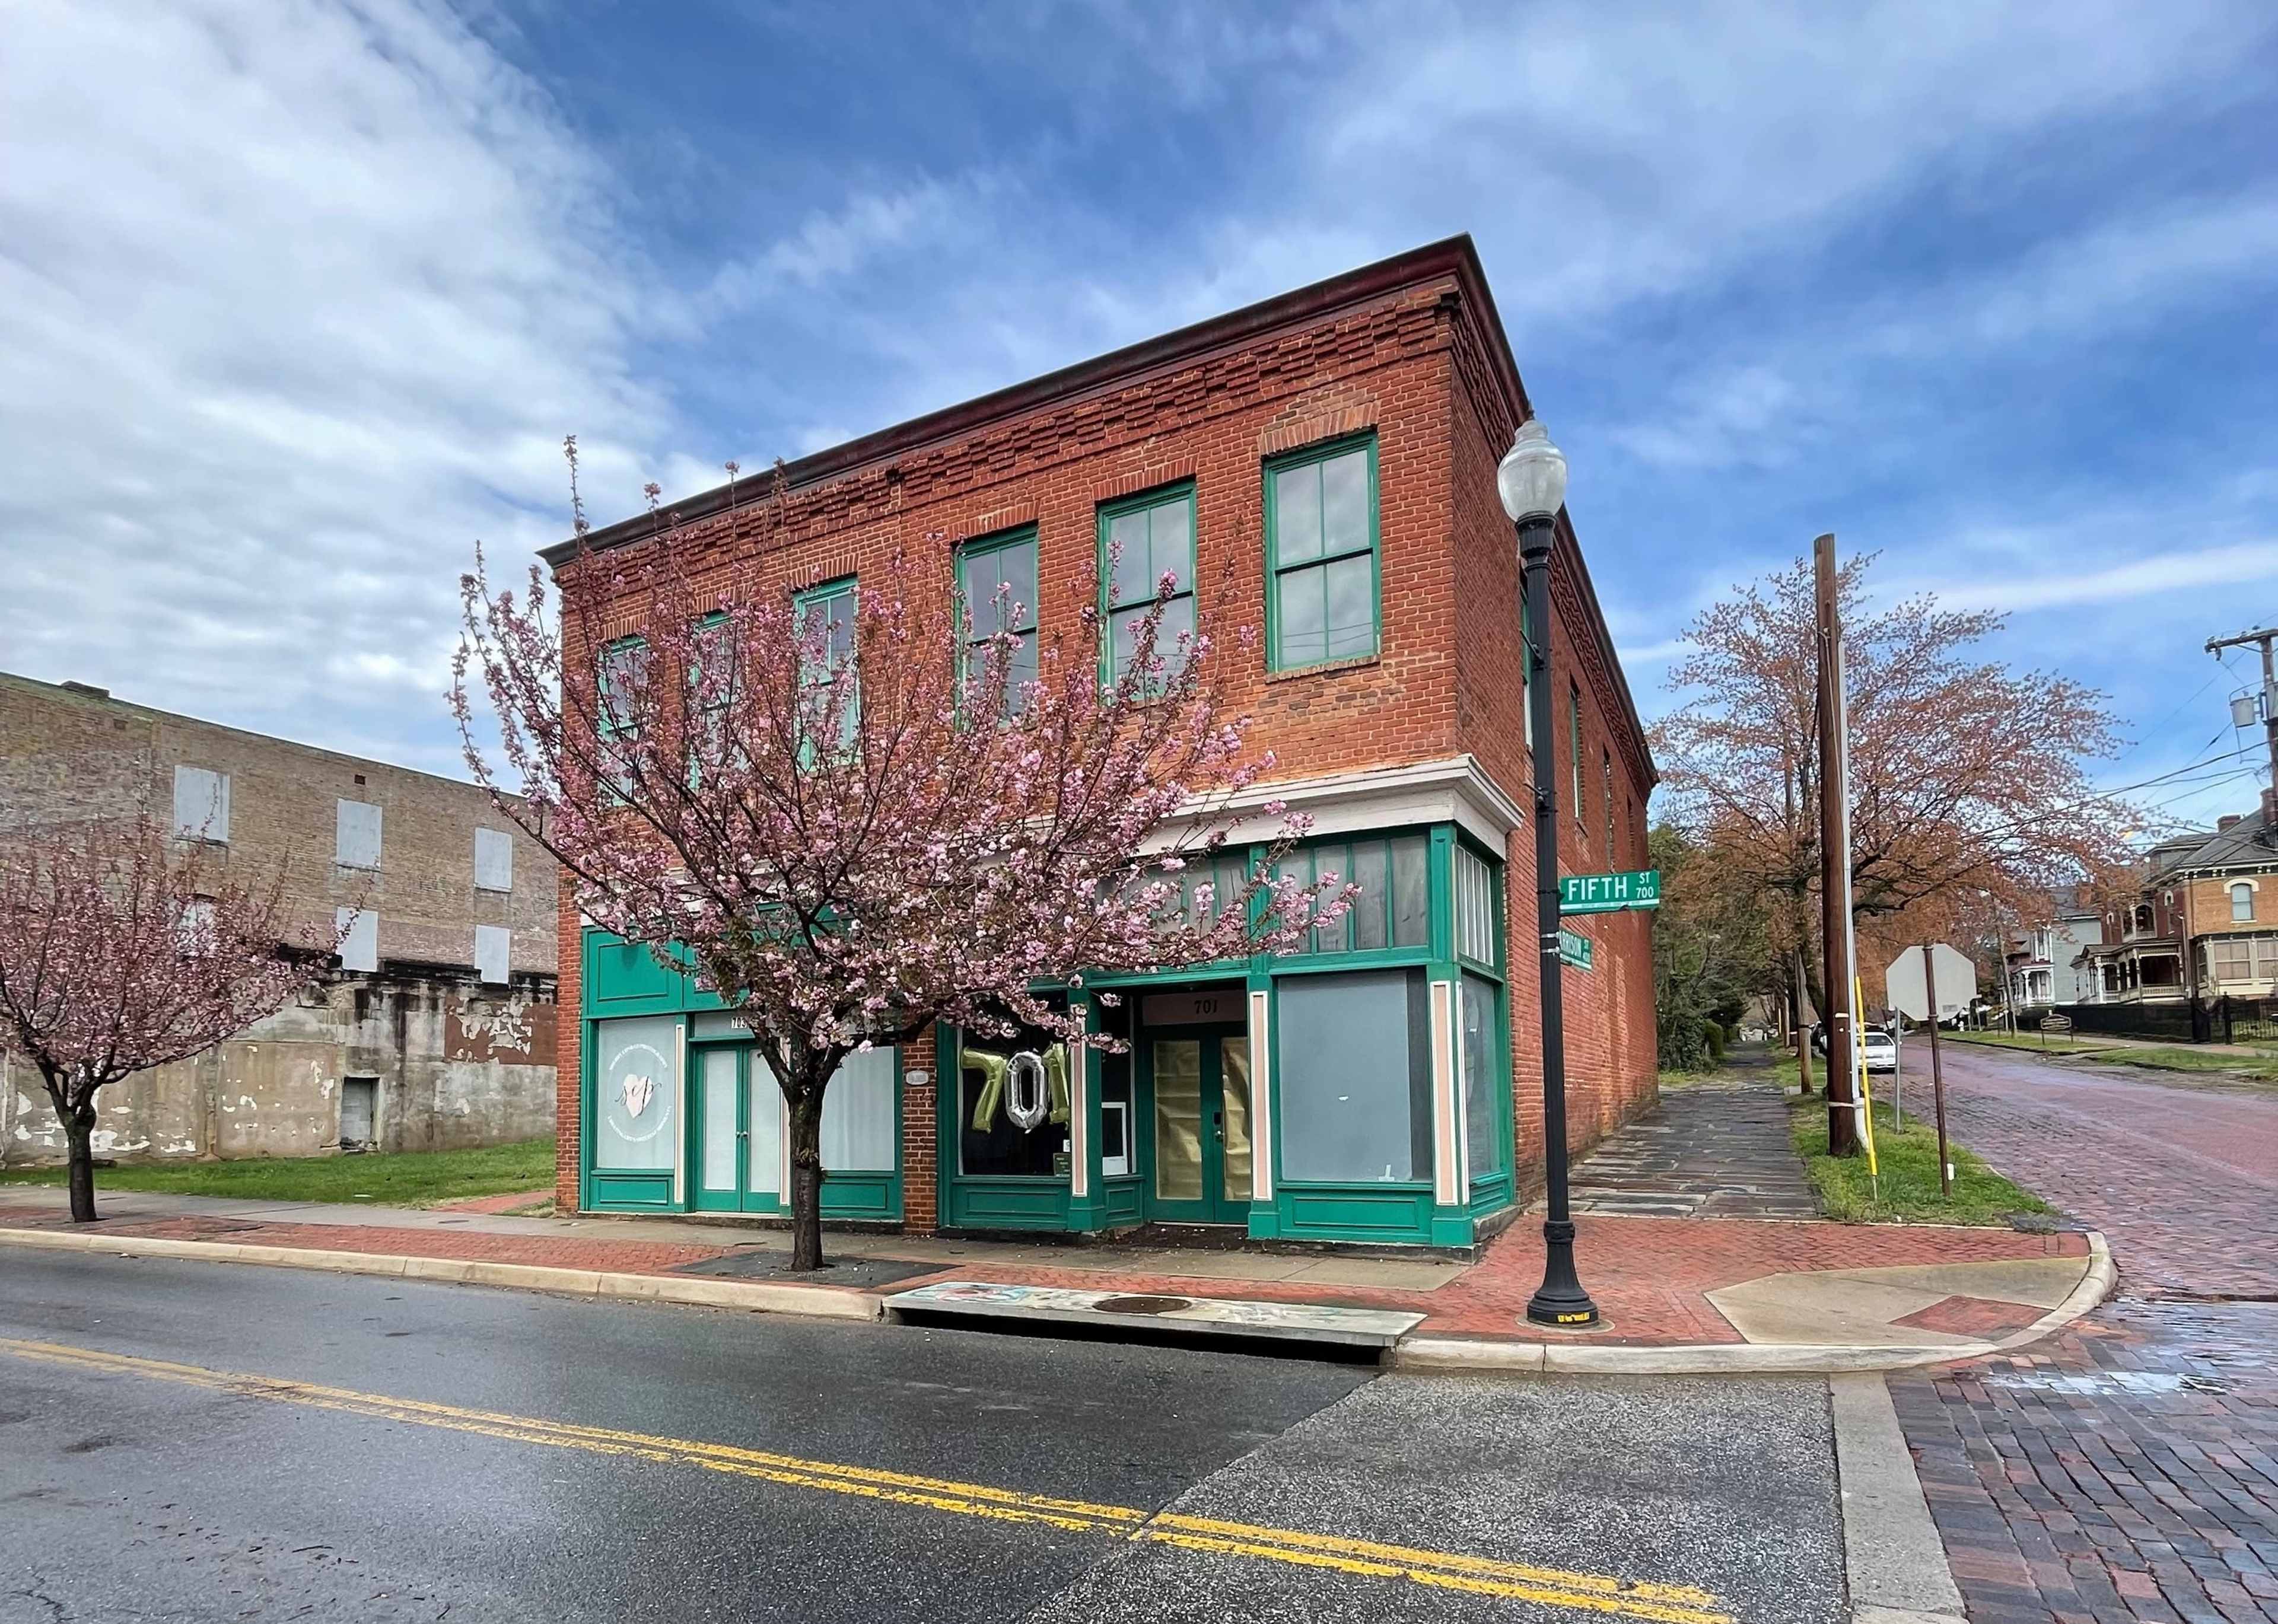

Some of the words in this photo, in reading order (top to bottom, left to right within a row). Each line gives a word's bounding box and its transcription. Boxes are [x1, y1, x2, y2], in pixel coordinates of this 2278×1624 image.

[1568, 876, 1627, 901] FIFTH
[1639, 872, 1650, 884] ST
[1636, 886, 1655, 899] 700
[1560, 929, 1582, 959] ARRISON
[1194, 999, 1217, 1014] 701
[732, 1017, 747, 1028] 703
[961, 1042, 1070, 1133] 701
